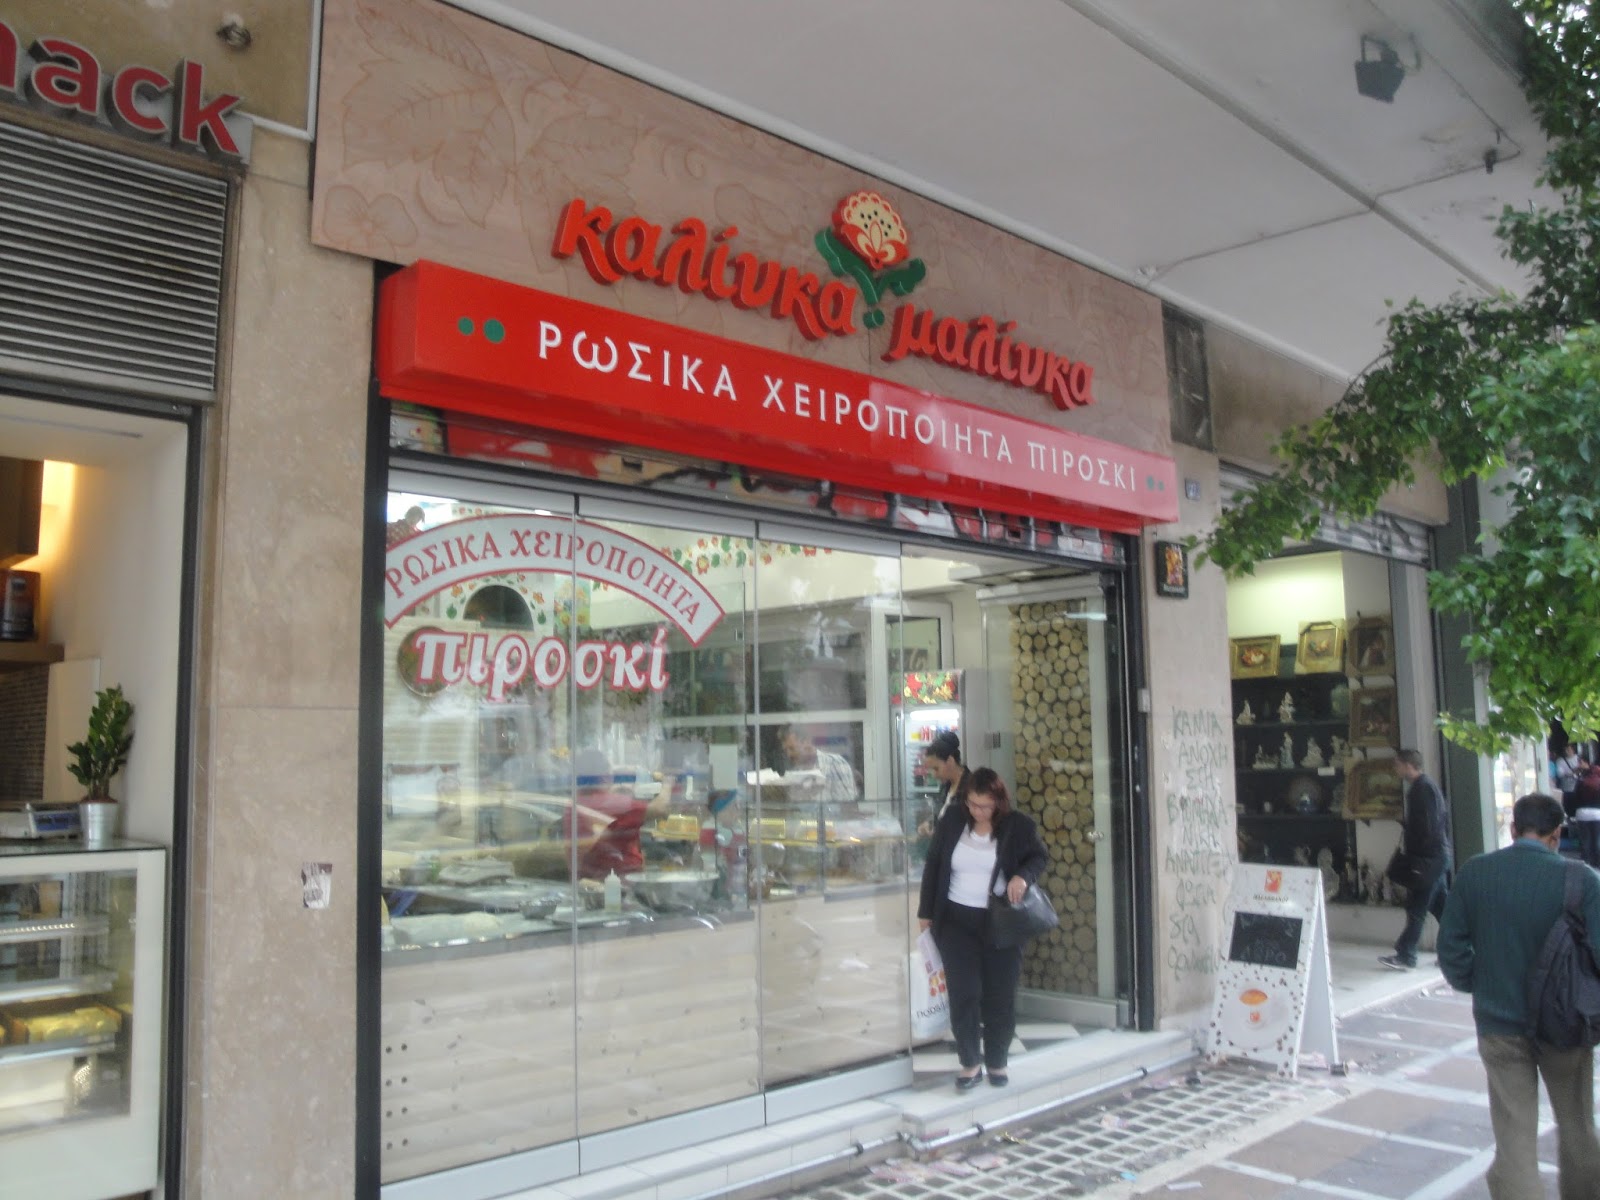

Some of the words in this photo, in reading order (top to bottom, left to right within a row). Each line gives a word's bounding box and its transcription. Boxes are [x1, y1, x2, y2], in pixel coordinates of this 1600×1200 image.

[762, 375, 1013, 464] ΧΕΙΡΟΠΟΙΗΤΑ
[1027, 441, 1137, 492] ΠΙΡΟΣΚΙ
[386, 532, 502, 598] ΡΩΣΙΚΑ
[510, 529, 702, 625] ΧΕΙΡΟΠΟΙΗΤΑ
[415, 626, 670, 702] πιροσκί
